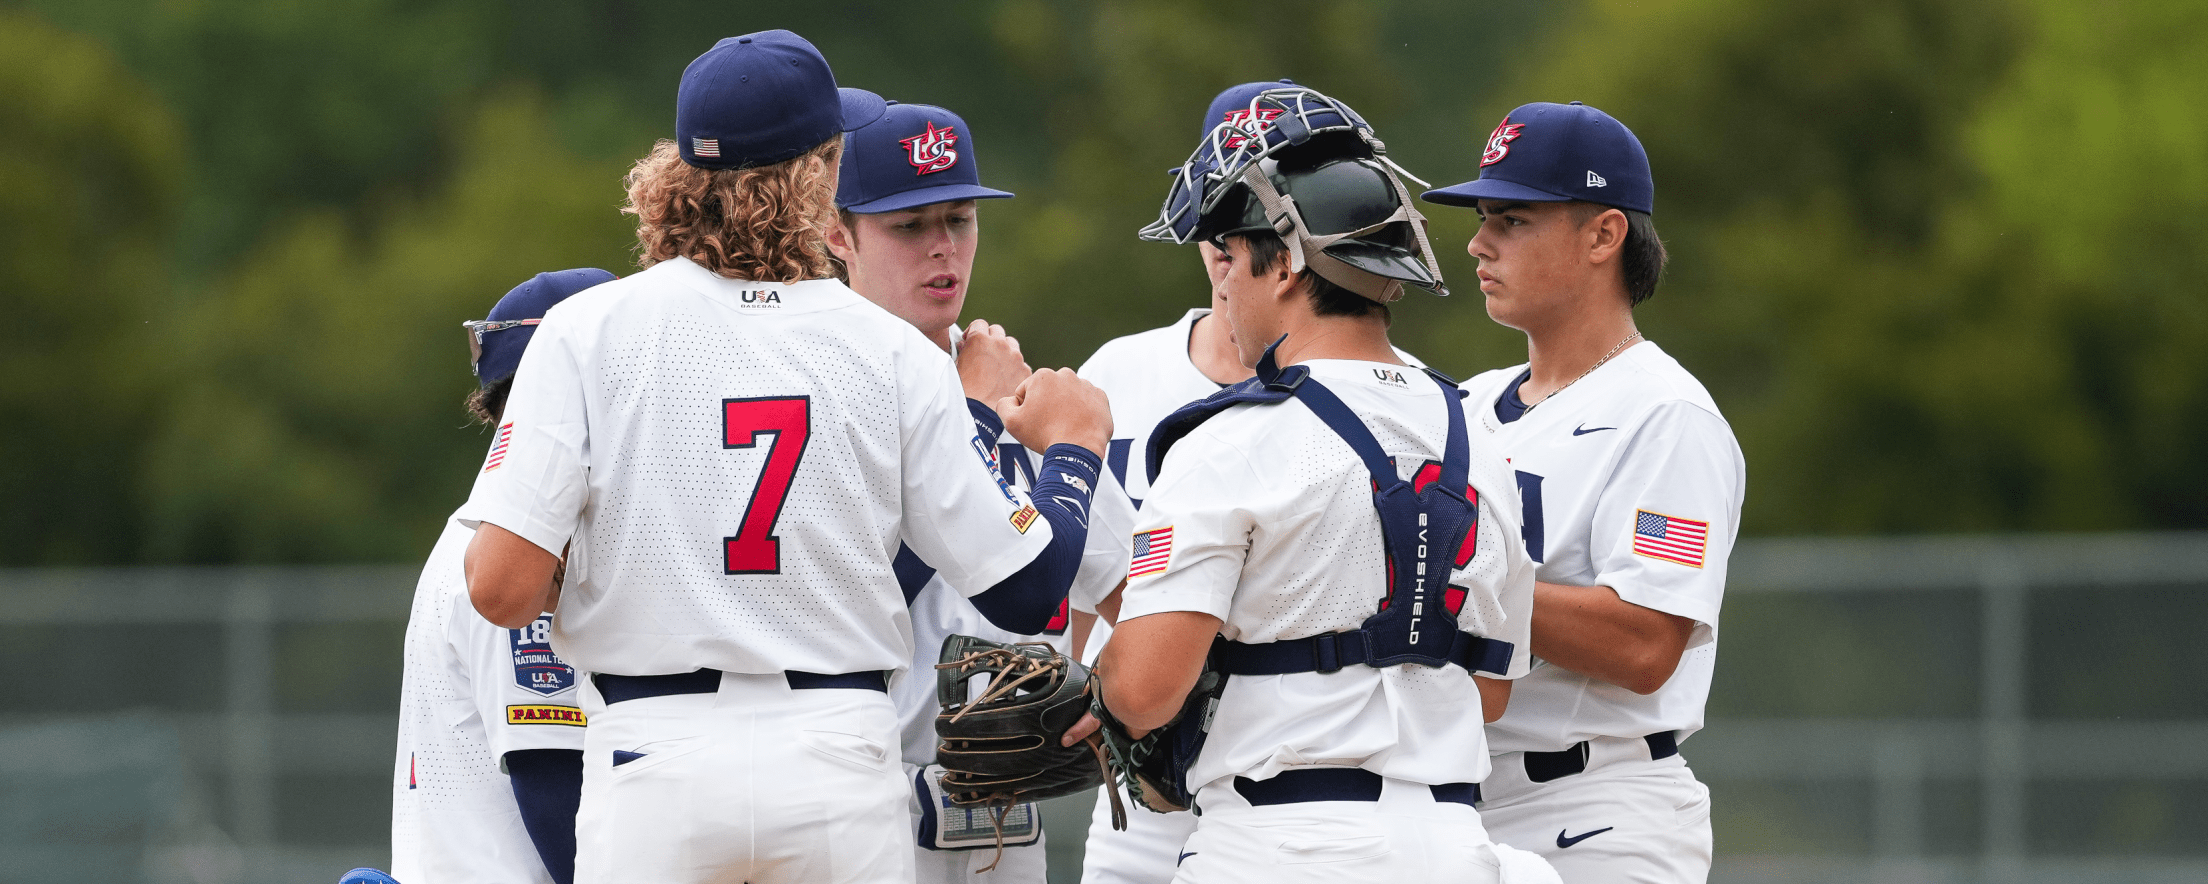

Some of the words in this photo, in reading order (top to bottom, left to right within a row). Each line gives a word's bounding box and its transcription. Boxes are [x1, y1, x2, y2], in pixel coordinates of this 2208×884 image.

[904, 127, 958, 174] US
[741, 289, 781, 303] USA
[1372, 368, 1408, 385] USA
[722, 395, 811, 575] 7
[1409, 512, 1428, 646] EVOSHIELD
[515, 654, 552, 666] NATIONAL
[531, 672, 559, 684] USA
[512, 708, 583, 722] PANINI
